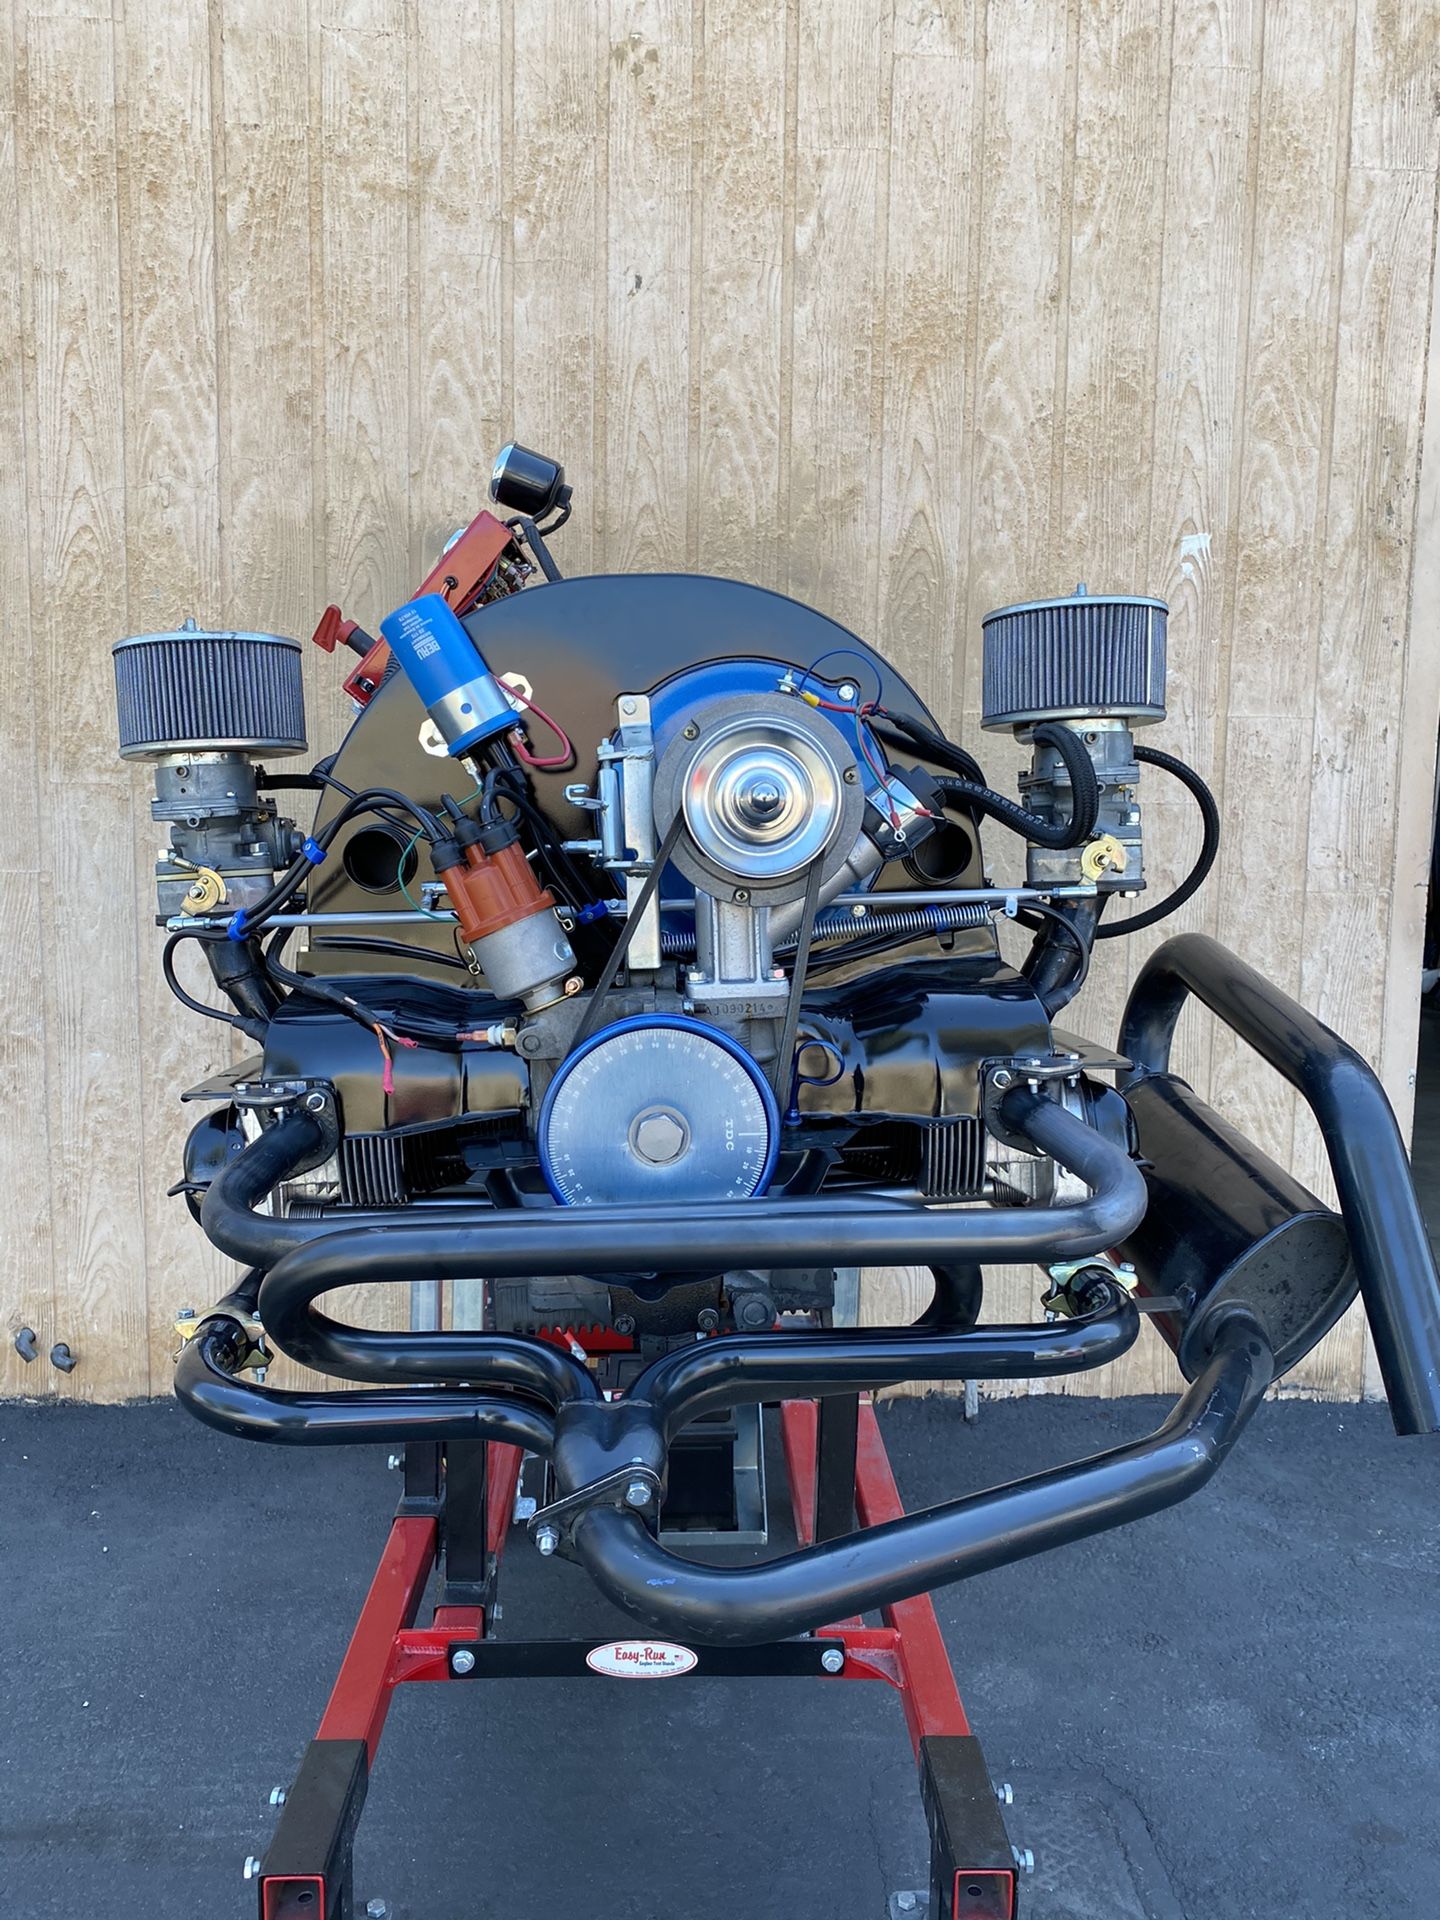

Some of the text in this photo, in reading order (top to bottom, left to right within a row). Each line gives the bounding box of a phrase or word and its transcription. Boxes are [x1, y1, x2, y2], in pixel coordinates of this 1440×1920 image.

[416, 640, 441, 660] BERU
[725, 1119, 734, 1151] TDC
[614, 1647, 666, 1663] Easy-Run
